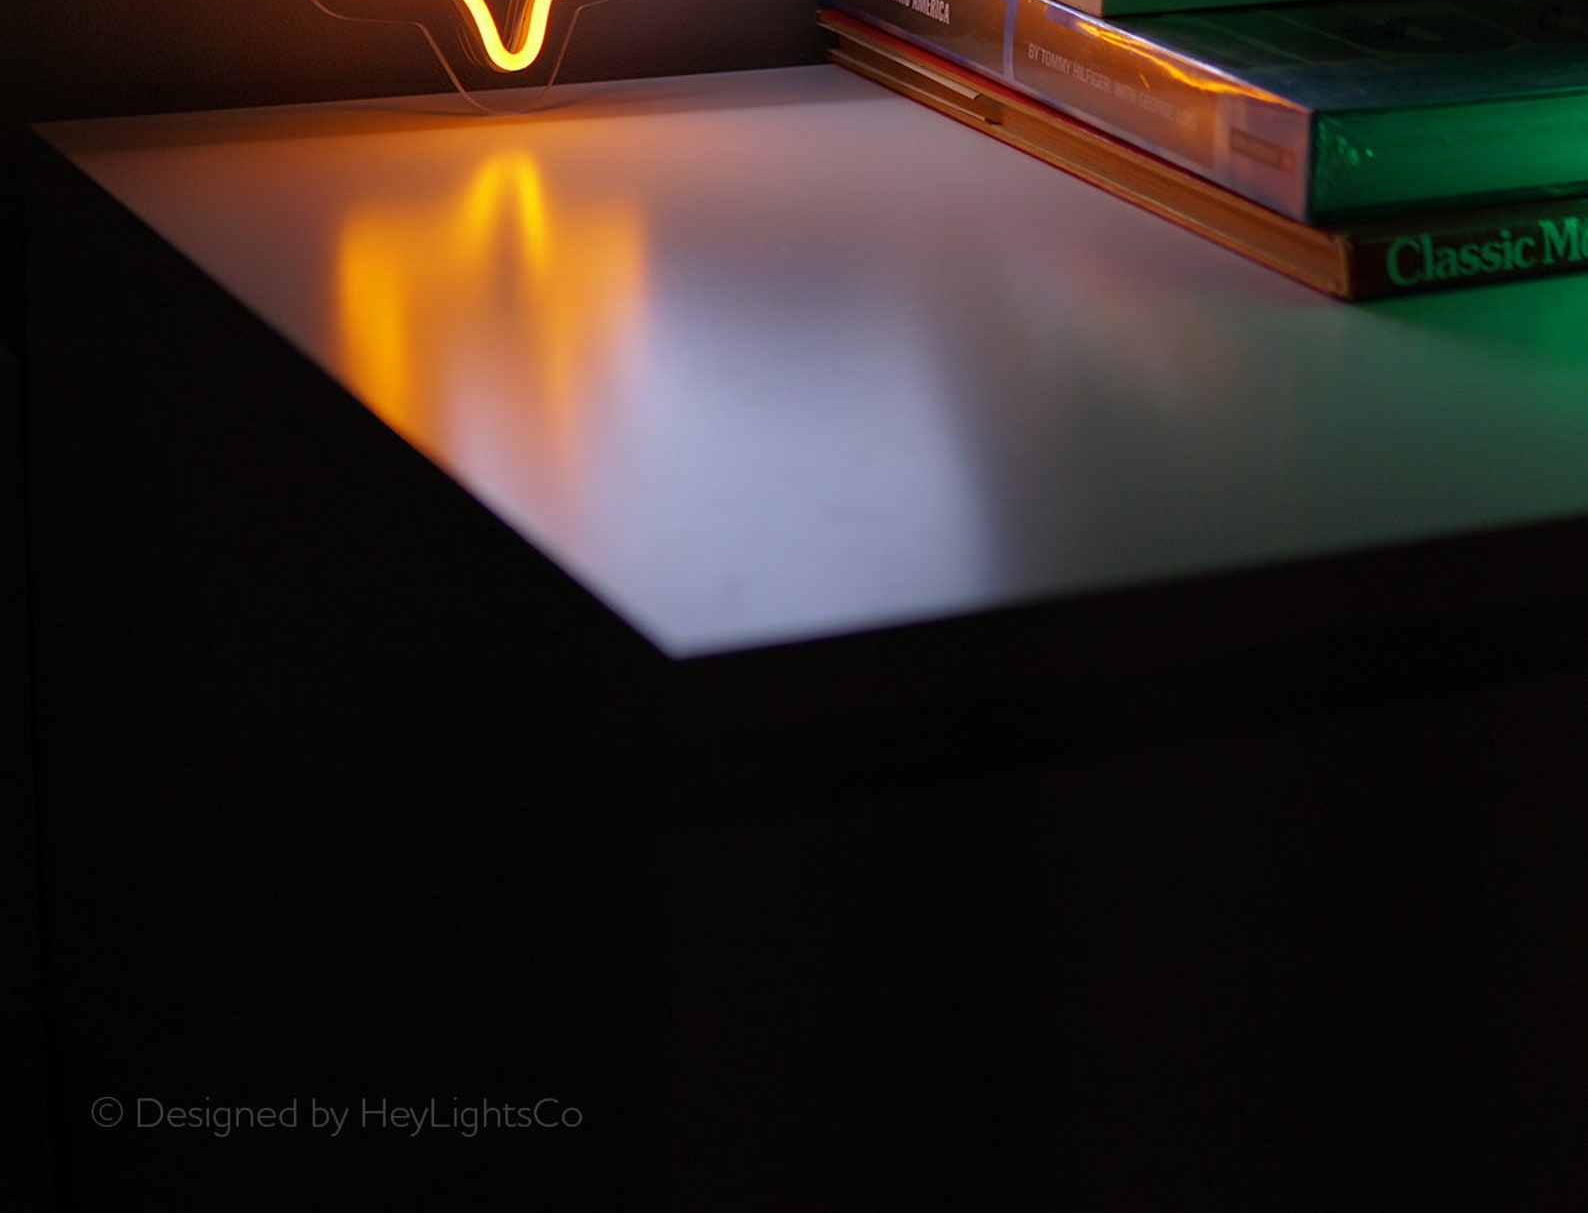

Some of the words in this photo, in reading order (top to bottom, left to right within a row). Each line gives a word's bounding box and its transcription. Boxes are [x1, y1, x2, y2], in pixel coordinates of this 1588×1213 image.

[1028, 42, 1039, 60] BY
[1041, 48, 1071, 75] TOMMY
[1073, 63, 1111, 92] HILFIGER
[1385, 228, 1537, 288] Classic
